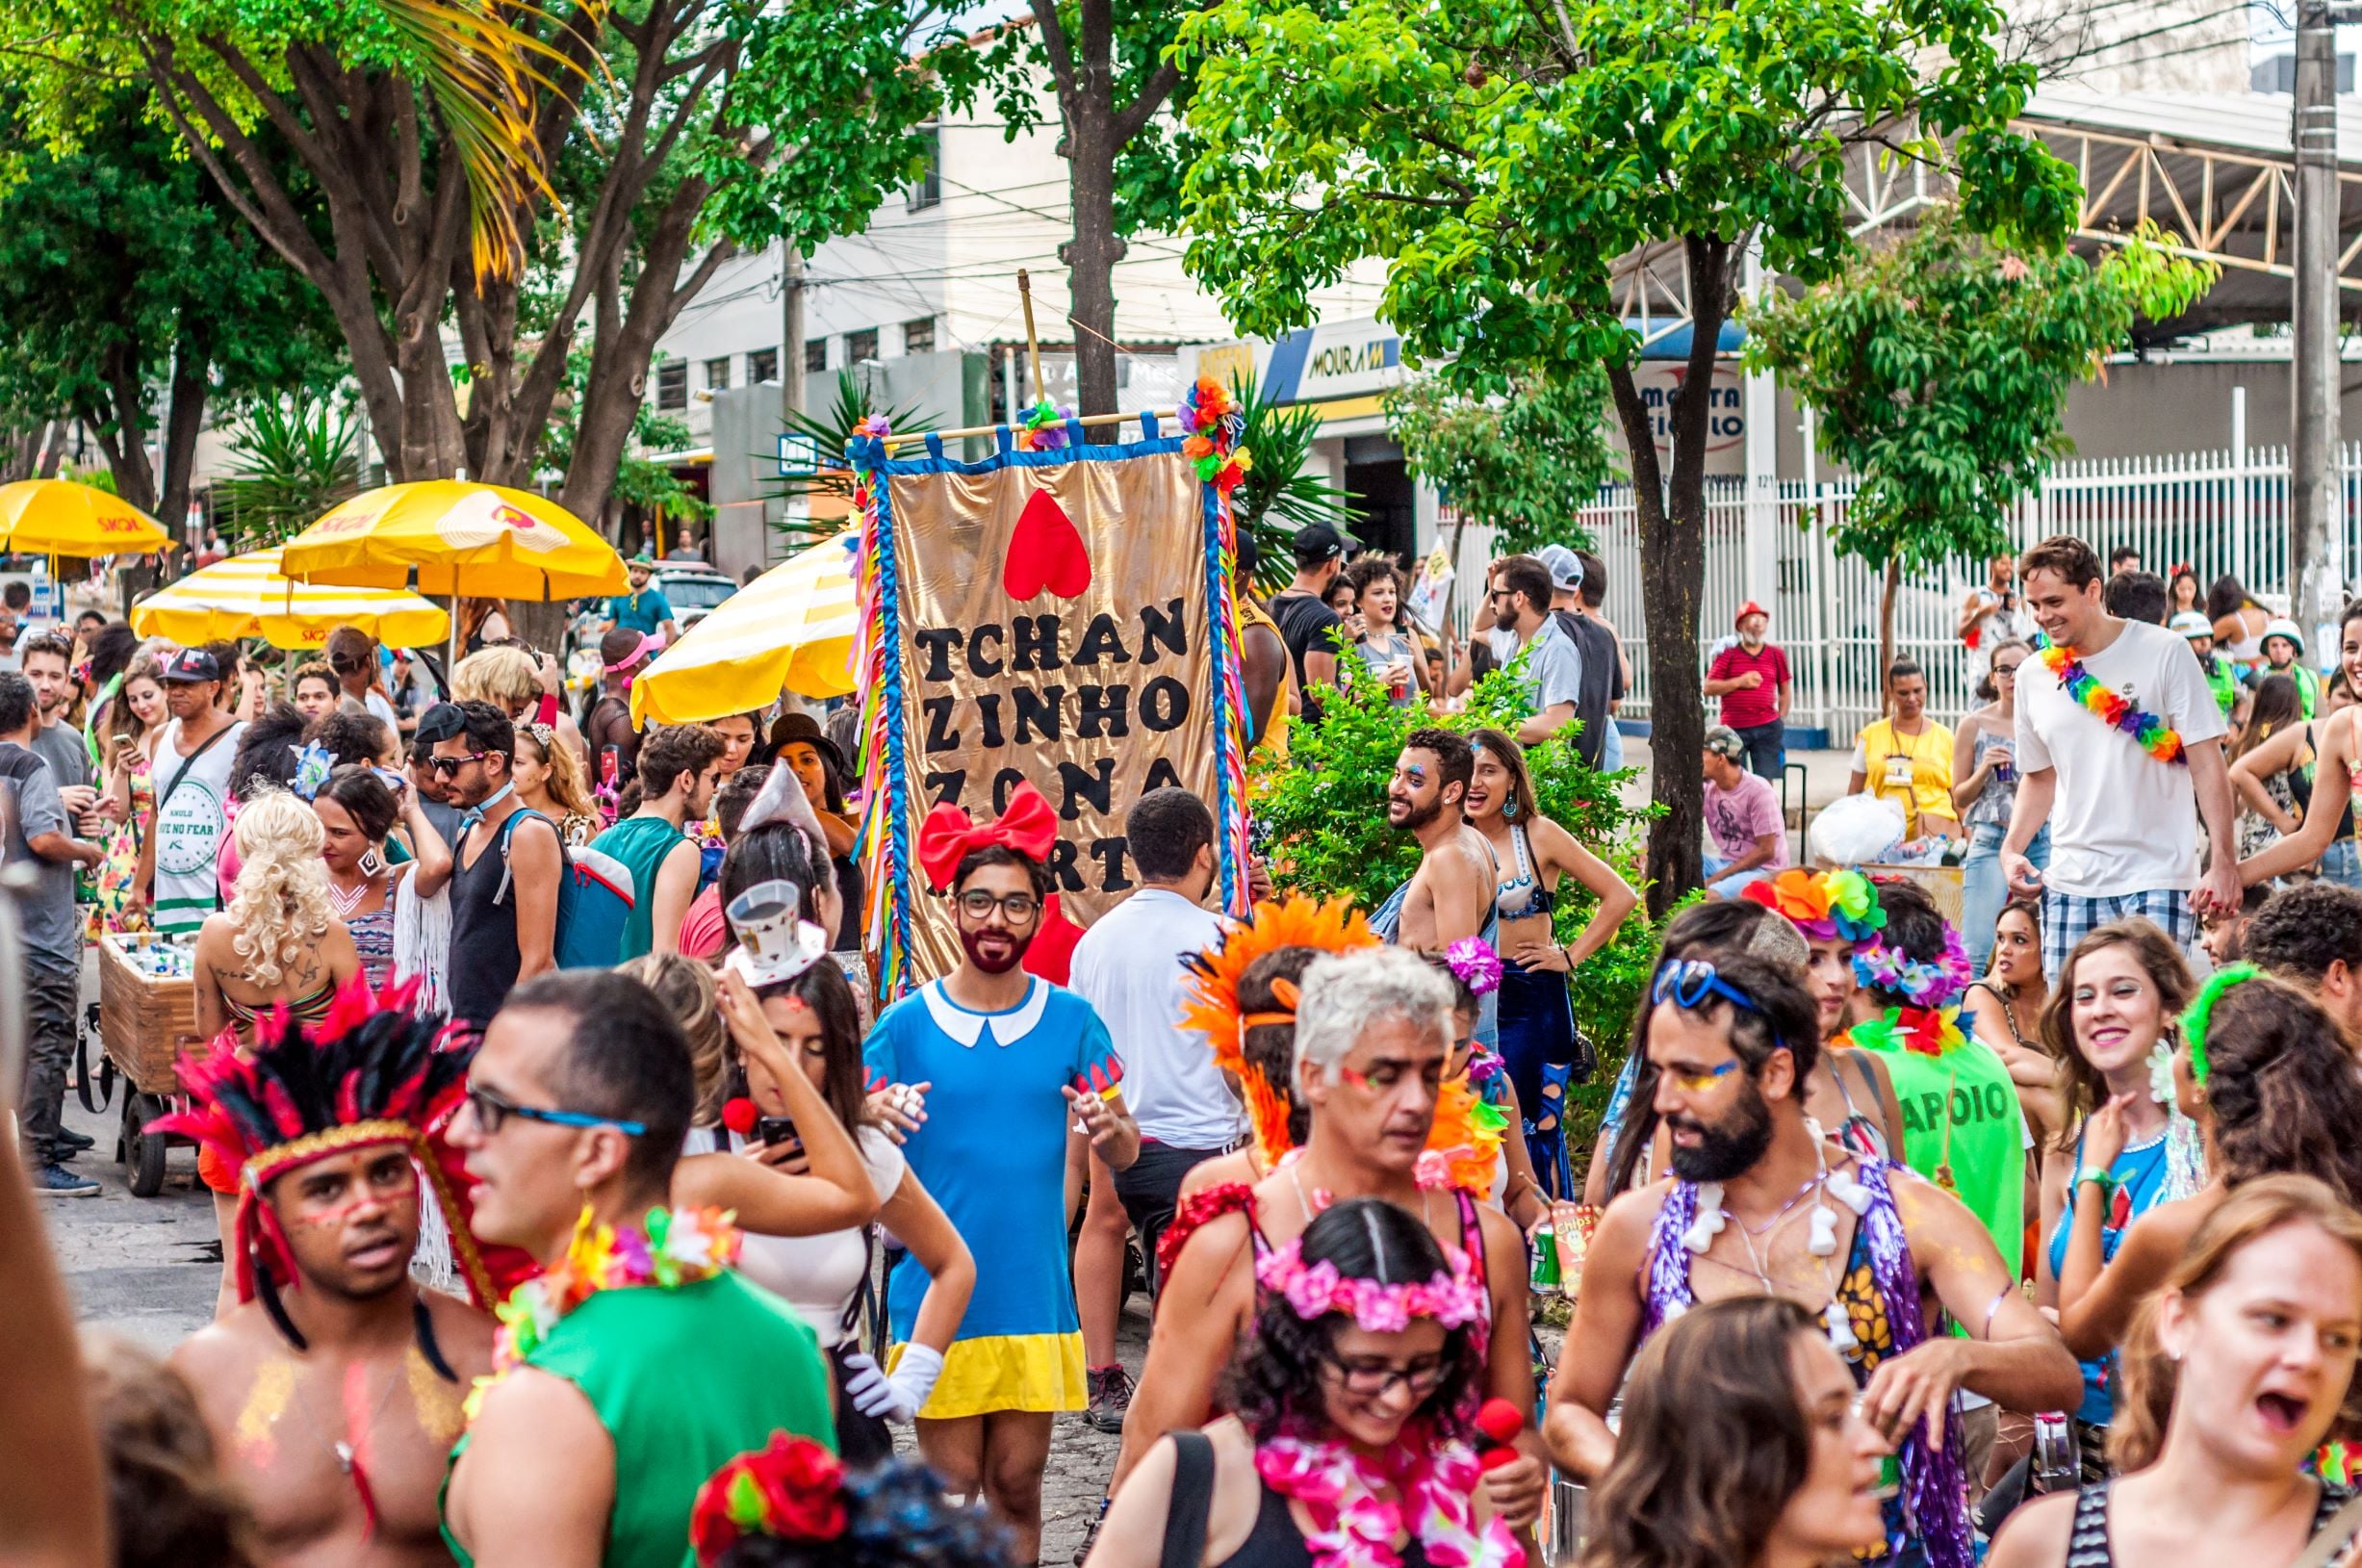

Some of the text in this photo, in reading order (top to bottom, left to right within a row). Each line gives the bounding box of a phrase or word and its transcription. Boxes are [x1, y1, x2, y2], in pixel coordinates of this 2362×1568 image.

[1309, 346, 1365, 378] MOURA
[301, 630, 327, 642] SKO
[914, 597, 1188, 681] TCHAN
[923, 676, 1190, 753] ZINHO
[172, 824, 185, 835] NO
[187, 825, 214, 835] FEAR
[1900, 1082, 2008, 1133] APOIO
[1555, 1216, 1592, 1236] Chips
